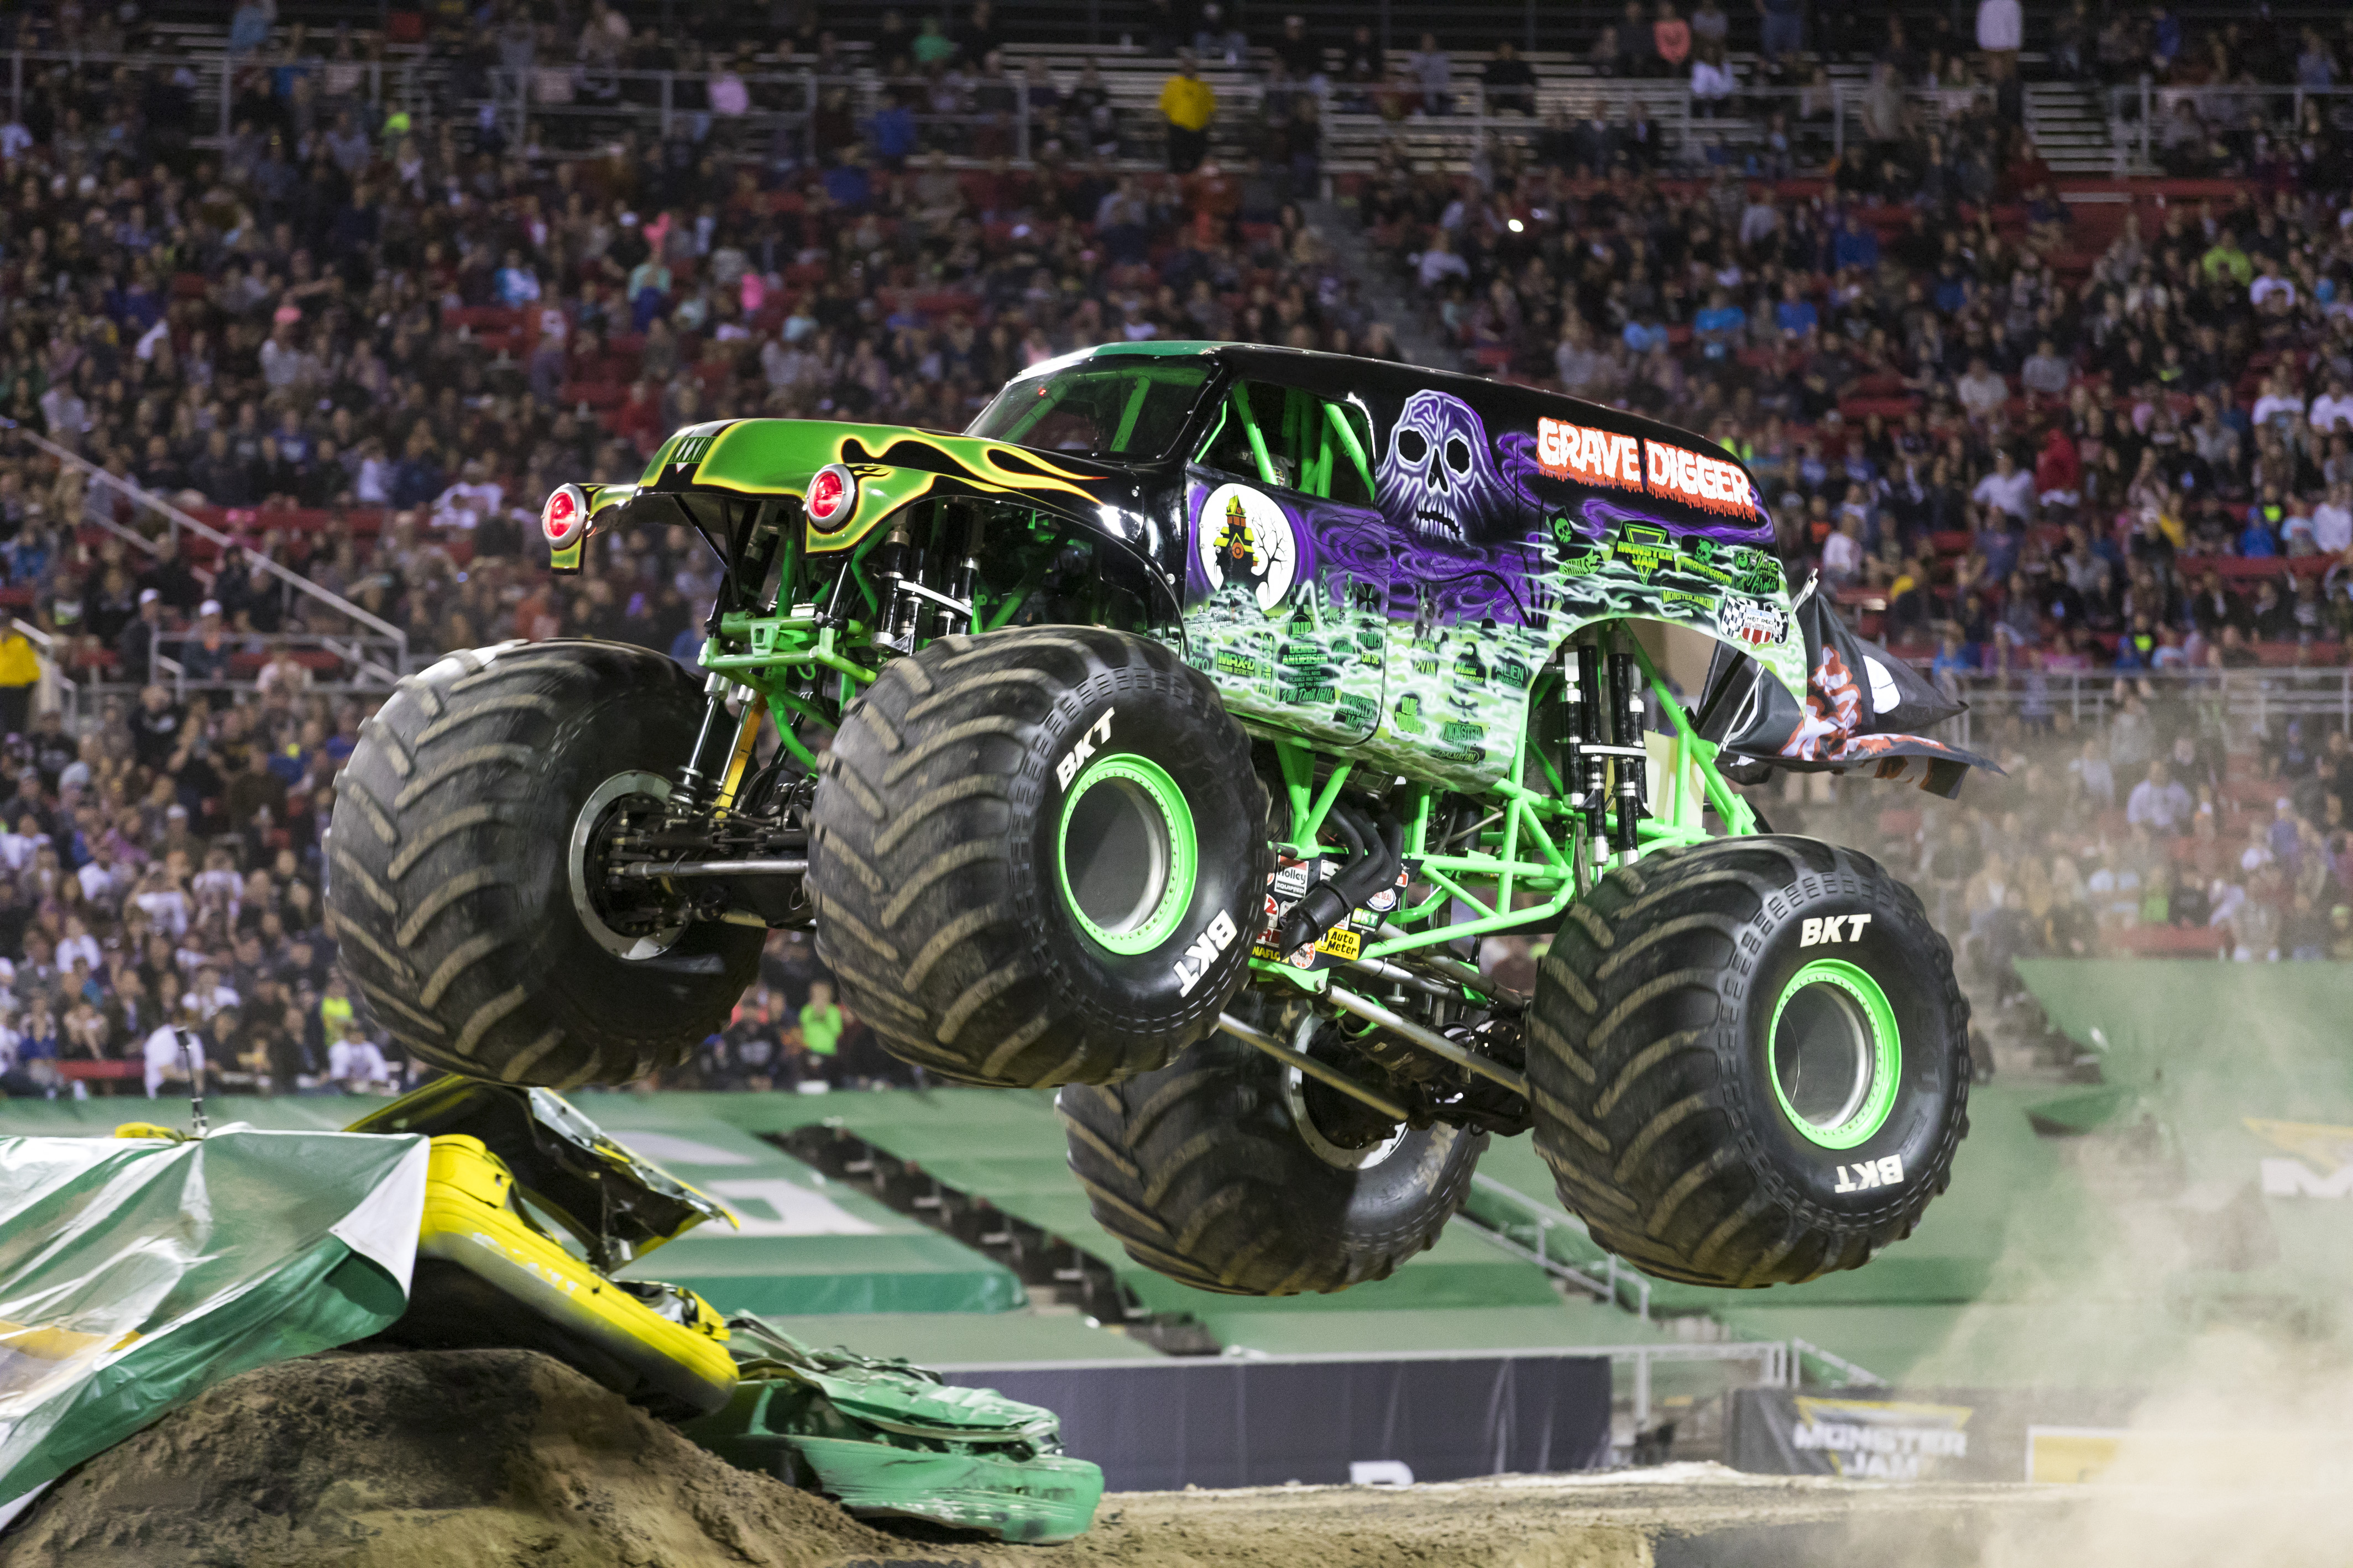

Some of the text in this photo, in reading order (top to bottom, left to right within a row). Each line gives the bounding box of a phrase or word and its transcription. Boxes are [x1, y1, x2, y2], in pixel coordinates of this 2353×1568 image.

[1538, 417, 1756, 515] GRAVE DIGGER
[1617, 540, 1674, 561] MONSTER
[1632, 554, 1659, 569] JAM
[1292, 622, 1312, 634] RIP
[1414, 638, 1436, 654] ADAM
[1218, 651, 1256, 670] MAX-D
[1282, 653, 1329, 665] ANDERSON
[1414, 661, 1437, 677] RYAN
[1496, 662, 1524, 681] ALIEN
[1497, 673, 1522, 688] INVASION
[1282, 687, 1334, 702] Kill Devil Hills
[1341, 695, 1376, 719] MONSTER
[1402, 696, 1418, 716] BLUE
[1445, 723, 1482, 742] MONSTER
[1057, 707, 1115, 793] BKT
[1440, 751, 1477, 762] DALMATIAN
[1278, 865, 1307, 884] Holley
[1276, 882, 1305, 894] EQUIPPED
[1382, 891, 1392, 902] SEAL
[1353, 909, 1378, 925] BKT
[1331, 931, 1354, 945] Auto
[1800, 914, 1871, 947] BKT
[1173, 909, 1238, 998] BKT
[1327, 940, 1357, 955] Meter
[1834, 1153, 1904, 1193] BKT
[1793, 1421, 1968, 1457] MONSTER
